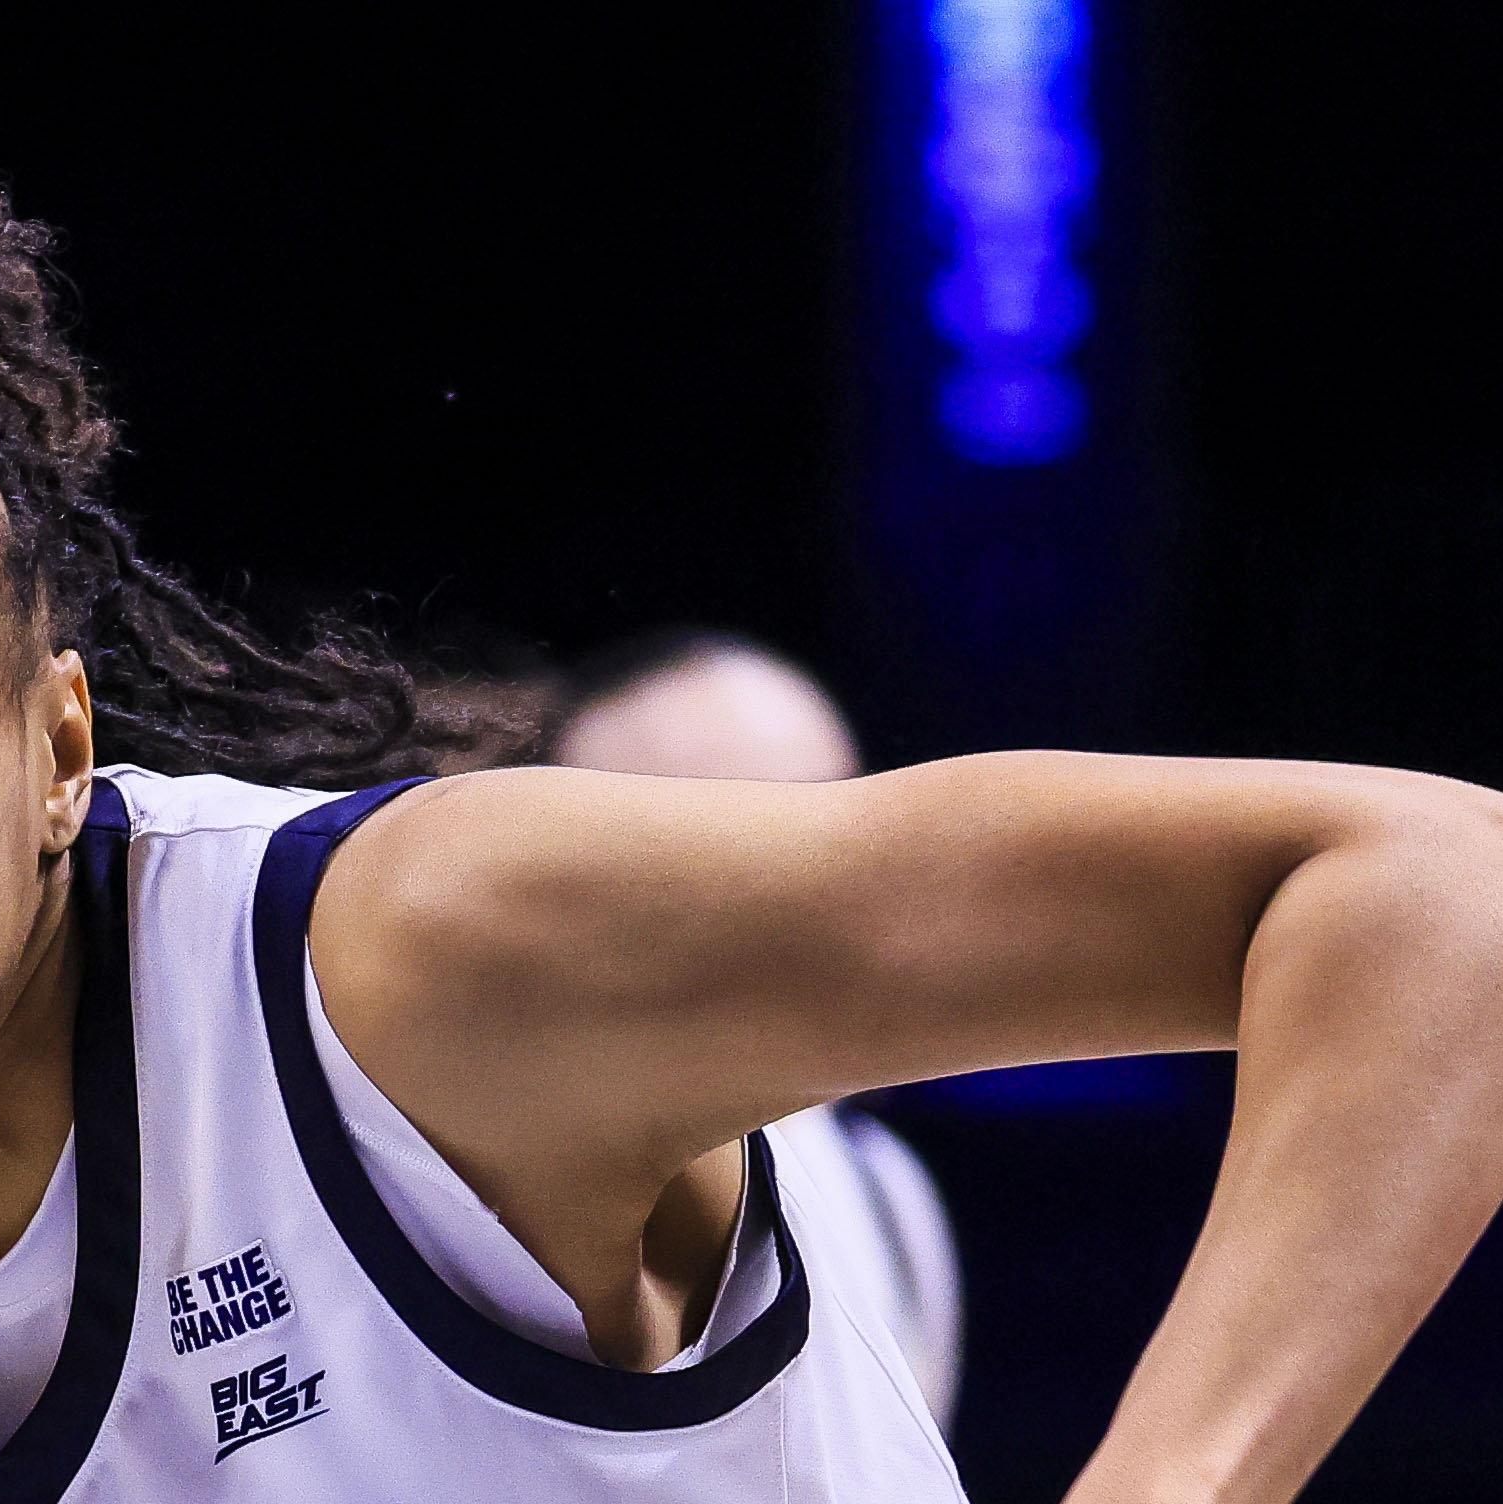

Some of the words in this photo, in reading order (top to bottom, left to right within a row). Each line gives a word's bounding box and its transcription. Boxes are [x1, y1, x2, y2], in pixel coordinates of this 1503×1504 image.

[166, 1275, 198, 1316] BE
[198, 1246, 270, 1304] THE
[170, 1277, 292, 1355] CHANGE
[210, 1354, 287, 1414] BIG
[217, 1370, 326, 1443] EAST
